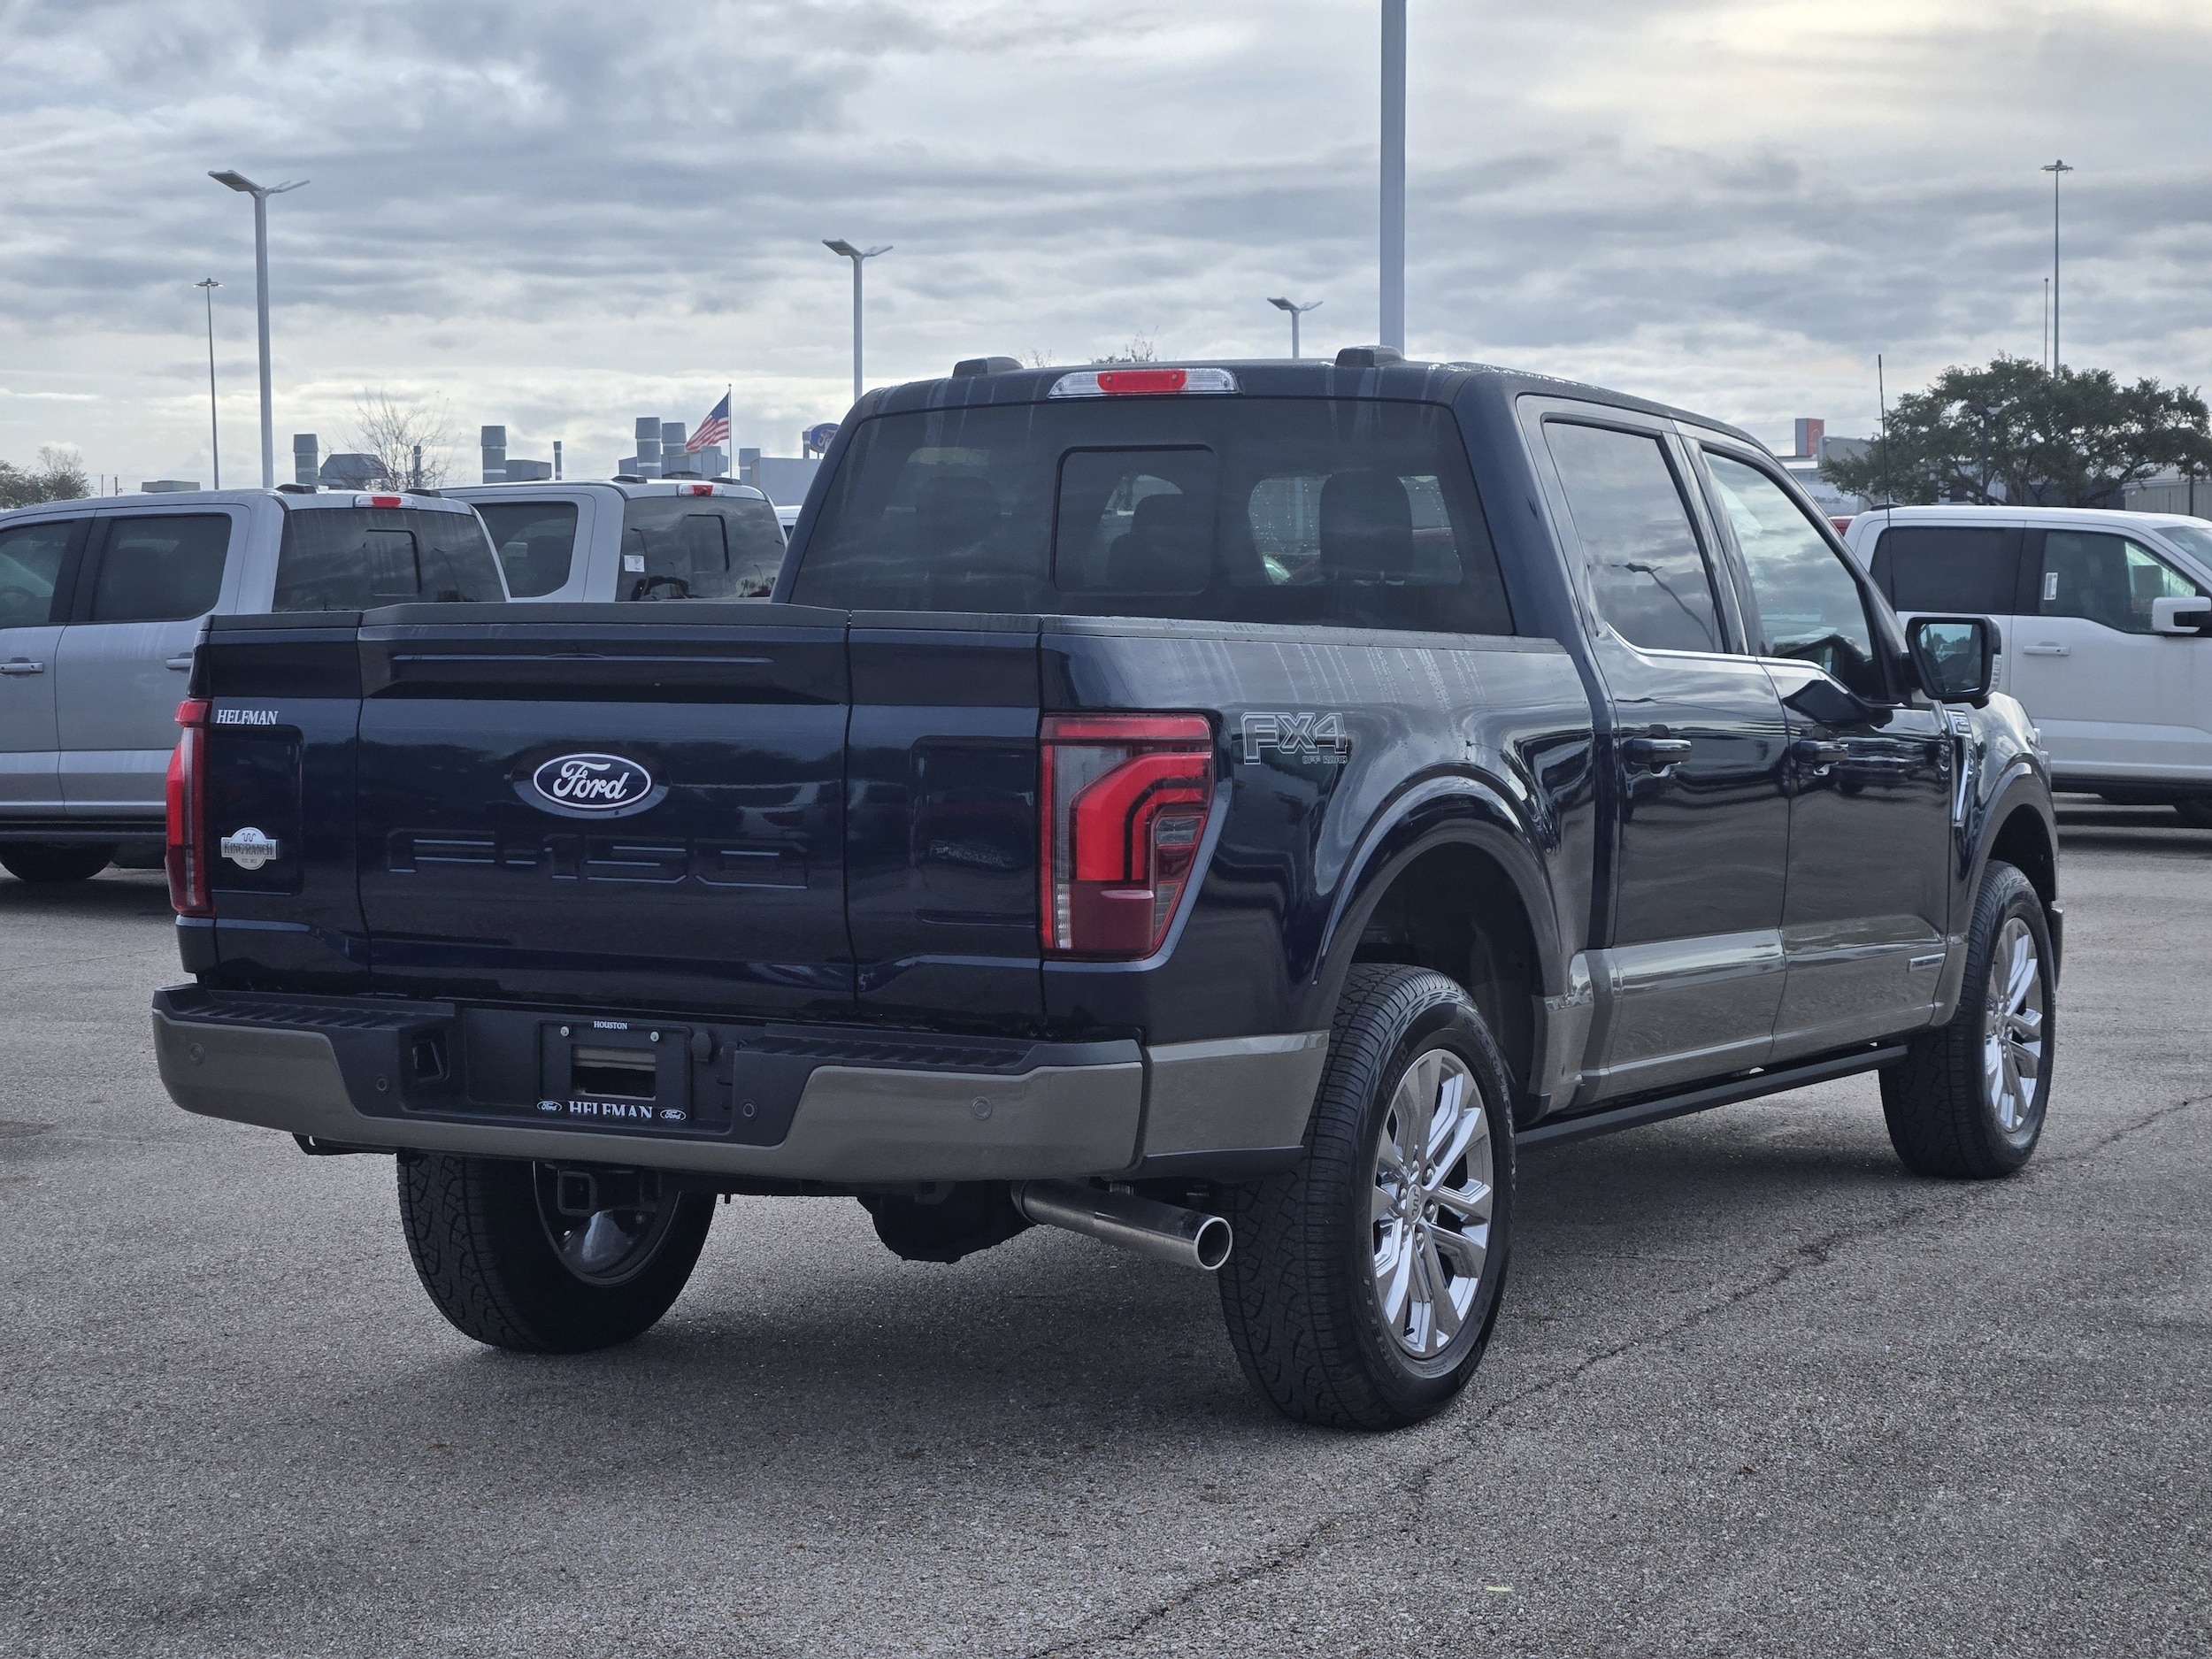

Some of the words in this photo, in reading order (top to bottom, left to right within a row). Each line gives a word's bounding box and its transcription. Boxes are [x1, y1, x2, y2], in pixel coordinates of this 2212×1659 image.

[216, 709, 279, 725] HELFMAN
[1240, 712, 1348, 764] FX4
[1302, 756, 1321, 764] OFF
[1323, 756, 1348, 764] ROAD
[552, 760, 630, 799] Ford
[224, 841, 244, 855] KING
[245, 843, 273, 856] RANCH
[388, 828, 809, 889] F-150
[594, 1020, 628, 1030] HOUSTON
[539, 1101, 559, 1111] Ford
[568, 1101, 653, 1118] HELFMAN
[662, 1110, 684, 1121] Ford
